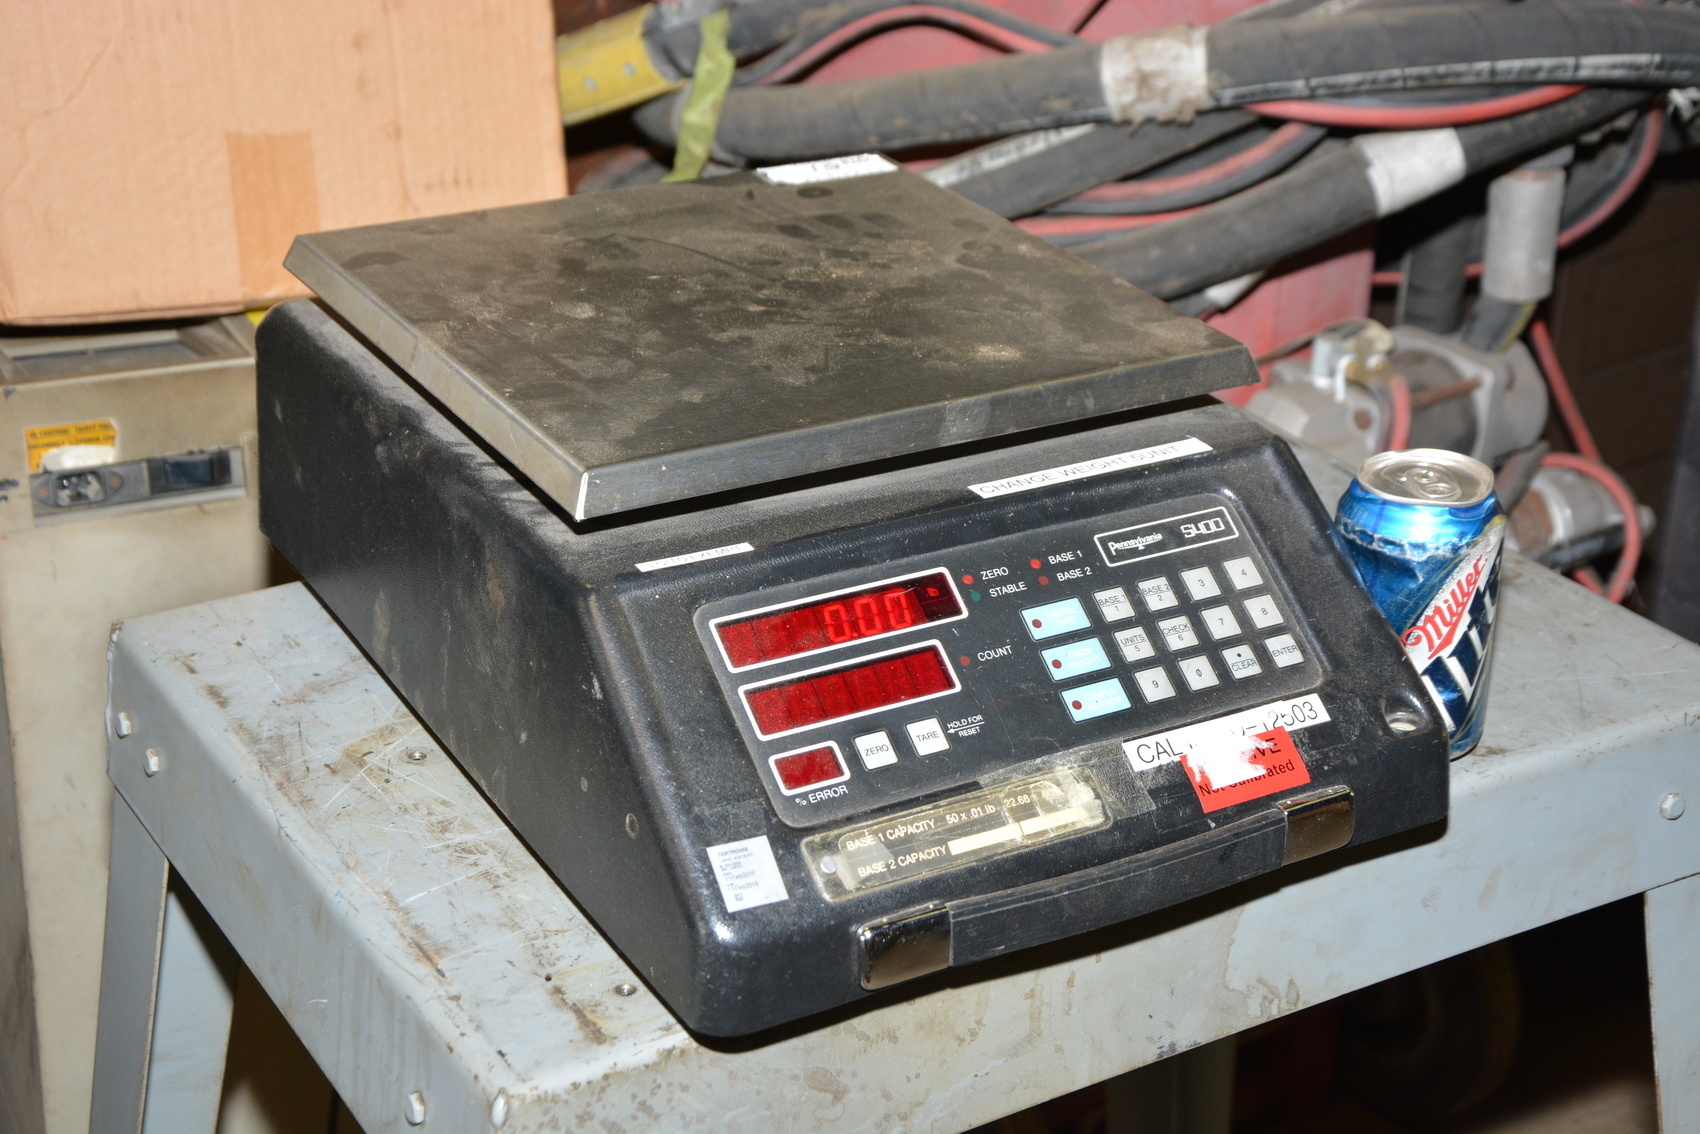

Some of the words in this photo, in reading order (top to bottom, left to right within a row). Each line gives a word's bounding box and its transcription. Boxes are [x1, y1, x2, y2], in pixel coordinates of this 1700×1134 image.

[979, 472, 1054, 494] CHANGE
[1057, 456, 1128, 477] WEIGHT
[1107, 532, 1163, 556] Pennsylvania
[1048, 551, 1075, 565] BASE
[1077, 549, 1083, 558] 1
[980, 566, 1009, 580] ZERO
[1056, 567, 1084, 582] BASE
[1084, 566, 1092, 575] 2
[1241, 569, 1247, 577] 4
[989, 581, 1027, 597] STABLE
[1198, 579, 1206, 587] 3
[1141, 585, 1163, 596] BASE
[1097, 595, 1121, 606] BASE
[1157, 594, 1164, 602] 2
[1401, 555, 1489, 654] Miller
[822, 587, 914, 644] 0.00
[1261, 607, 1269, 615] 8
[1218, 617, 1224, 626] 7
[1162, 623, 1190, 635] CHECK
[1120, 634, 1146, 646] UNITS
[977, 645, 1012, 662] COUNT
[1271, 644, 1299, 658] ENTER
[1231, 659, 1258, 672] CLEAR
[1195, 668, 1203, 677] 0
[1152, 680, 1159, 688] 9
[947, 719, 967, 730] HOLD
[968, 714, 984, 725] FOR
[916, 730, 940, 742] TARE
[958, 726, 981, 737] RESET
[864, 744, 889, 756] ZERO
[1136, 738, 1184, 764] CAL
[794, 797, 807, 807] %
[808, 785, 849, 805] ERROR
[845, 835, 876, 851] BASE
[878, 831, 885, 843] 1
[886, 819, 936, 840] CAPACITY
[945, 813, 960, 824] 50
[960, 813, 968, 821] x
[970, 807, 984, 818] .01
[985, 803, 996, 815] lb
[1003, 794, 1031, 810] 22.68
[857, 862, 888, 878] BASE
[888, 858, 897, 870] 2
[897, 844, 948, 867] CAPACITY
